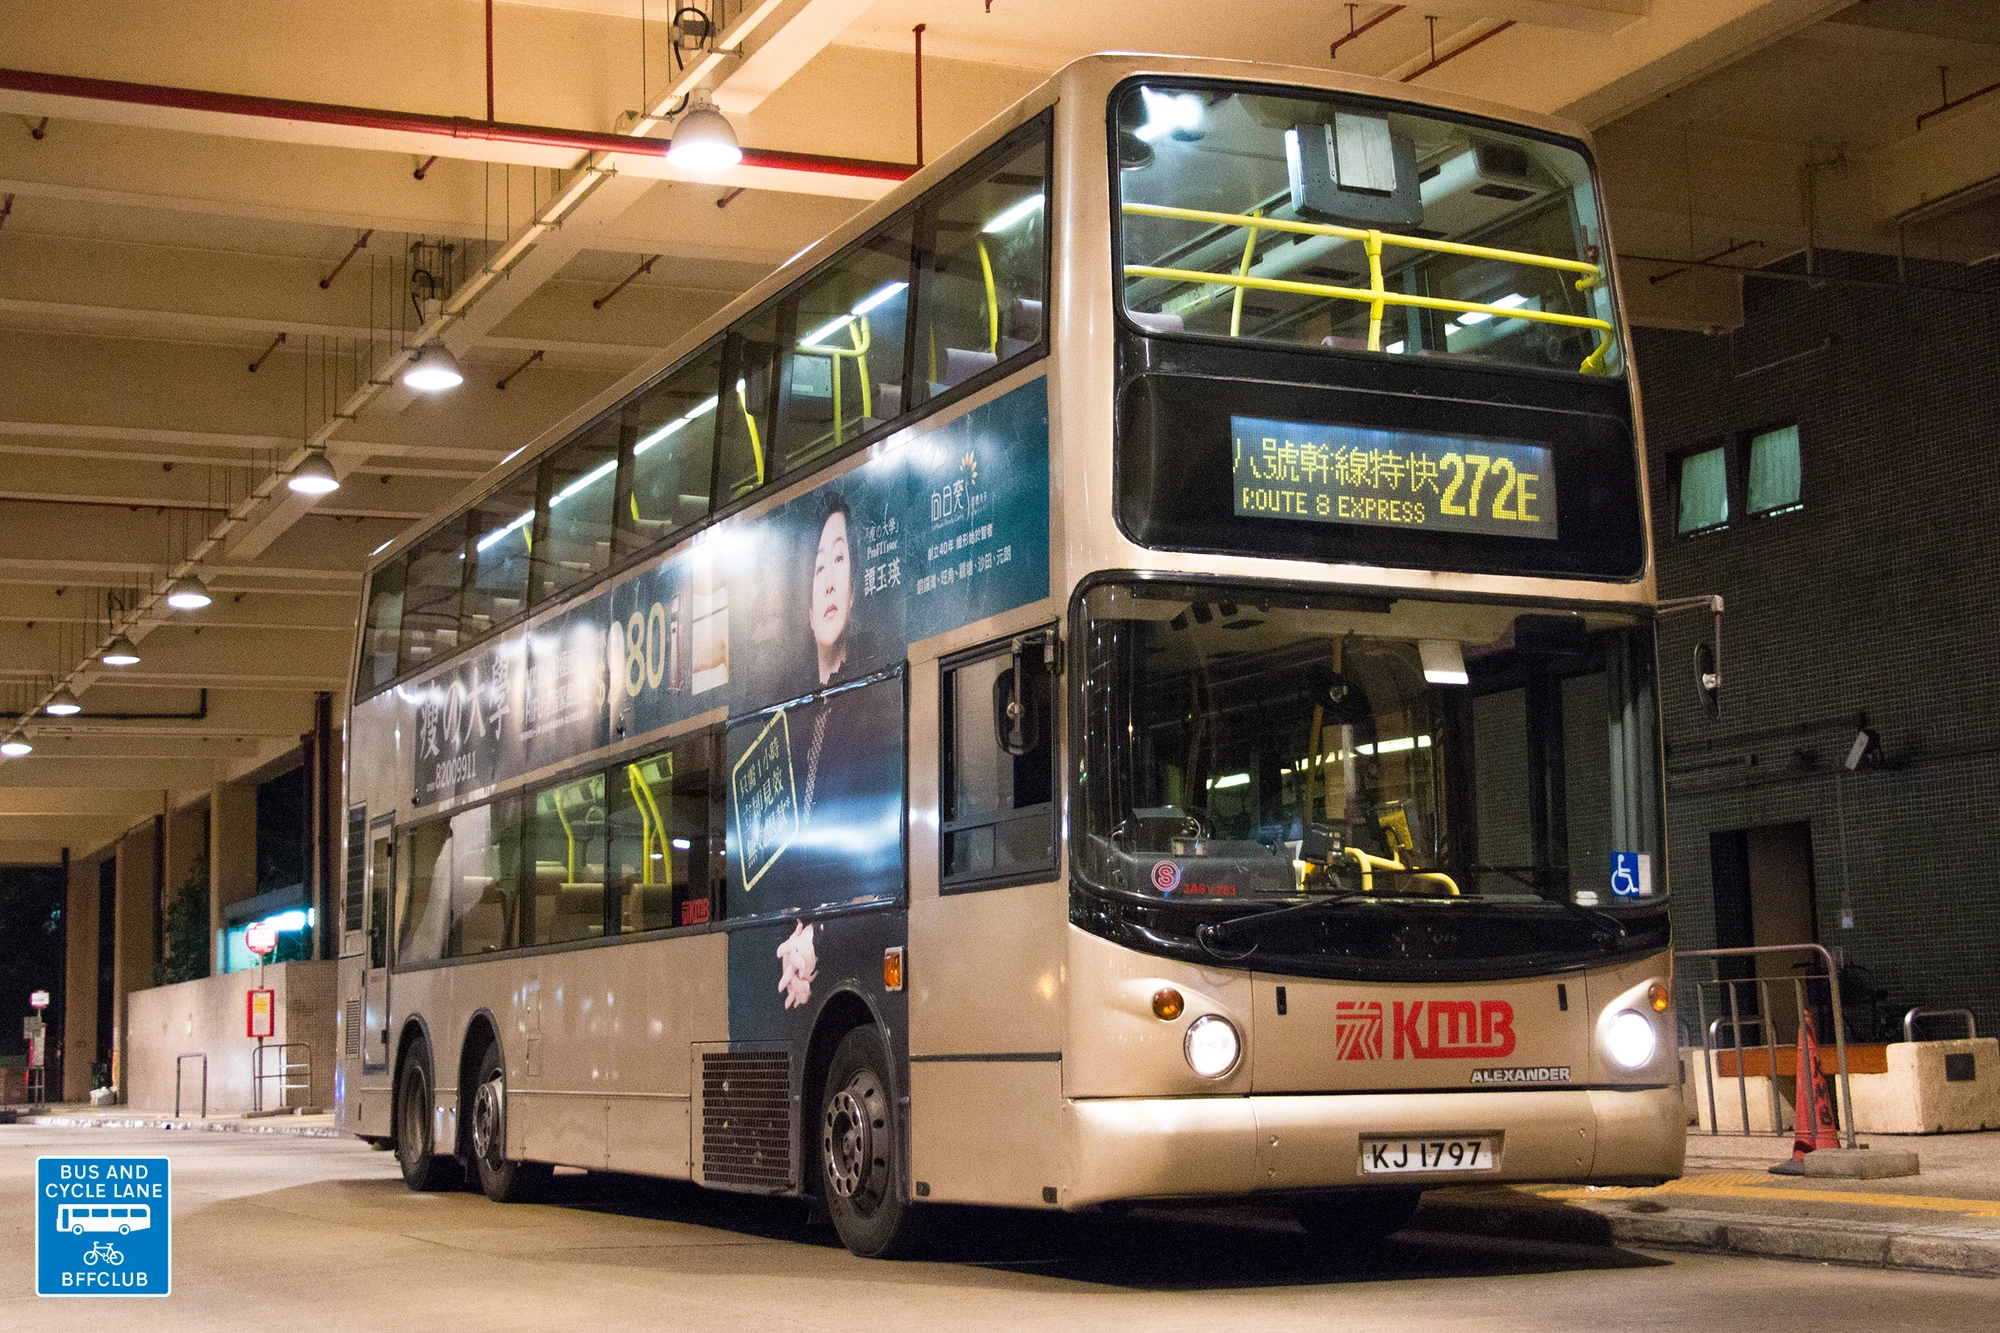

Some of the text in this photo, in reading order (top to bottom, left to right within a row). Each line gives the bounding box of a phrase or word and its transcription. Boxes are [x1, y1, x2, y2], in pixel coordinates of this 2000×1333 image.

[1233, 437, 1439, 494] 八號幹線特快
[931, 479, 964, 521] 向日葵
[1243, 487, 1425, 524] ROUTE 8 EXPRESS
[1439, 452, 1540, 522] 272E
[864, 556, 901, 597] 譚玉瑛
[435, 751, 476, 790] 82009911
[1392, 1000, 1517, 1060] KMB
[1471, 1067, 1571, 1083] ALEXANDER
[1371, 1141, 1482, 1169] KJ 1797
